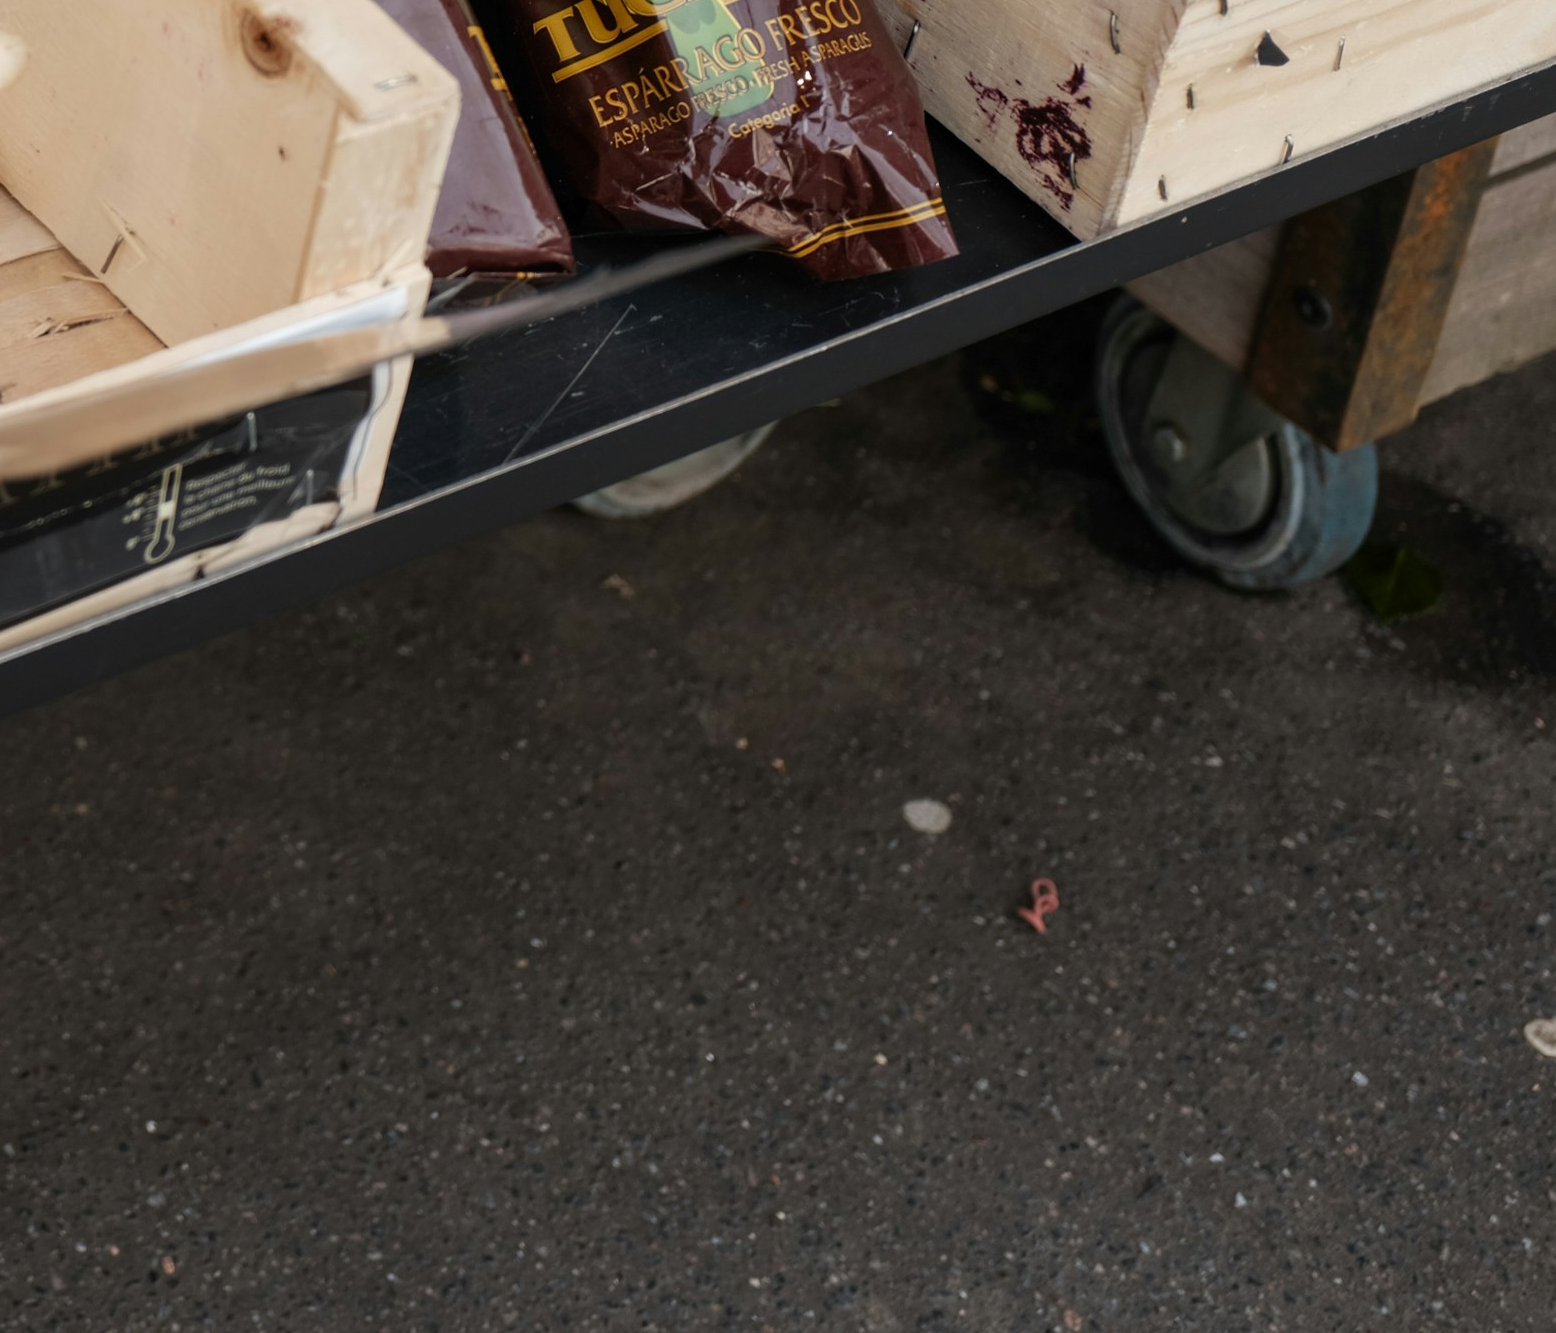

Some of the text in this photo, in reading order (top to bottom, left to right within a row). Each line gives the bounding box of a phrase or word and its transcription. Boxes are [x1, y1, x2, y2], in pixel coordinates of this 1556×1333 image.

[588, 27, 767, 129] ESPÁRRAGO
[612, 100, 692, 150] ASPARAGO
[799, 32, 873, 71] ASPARAGUS
